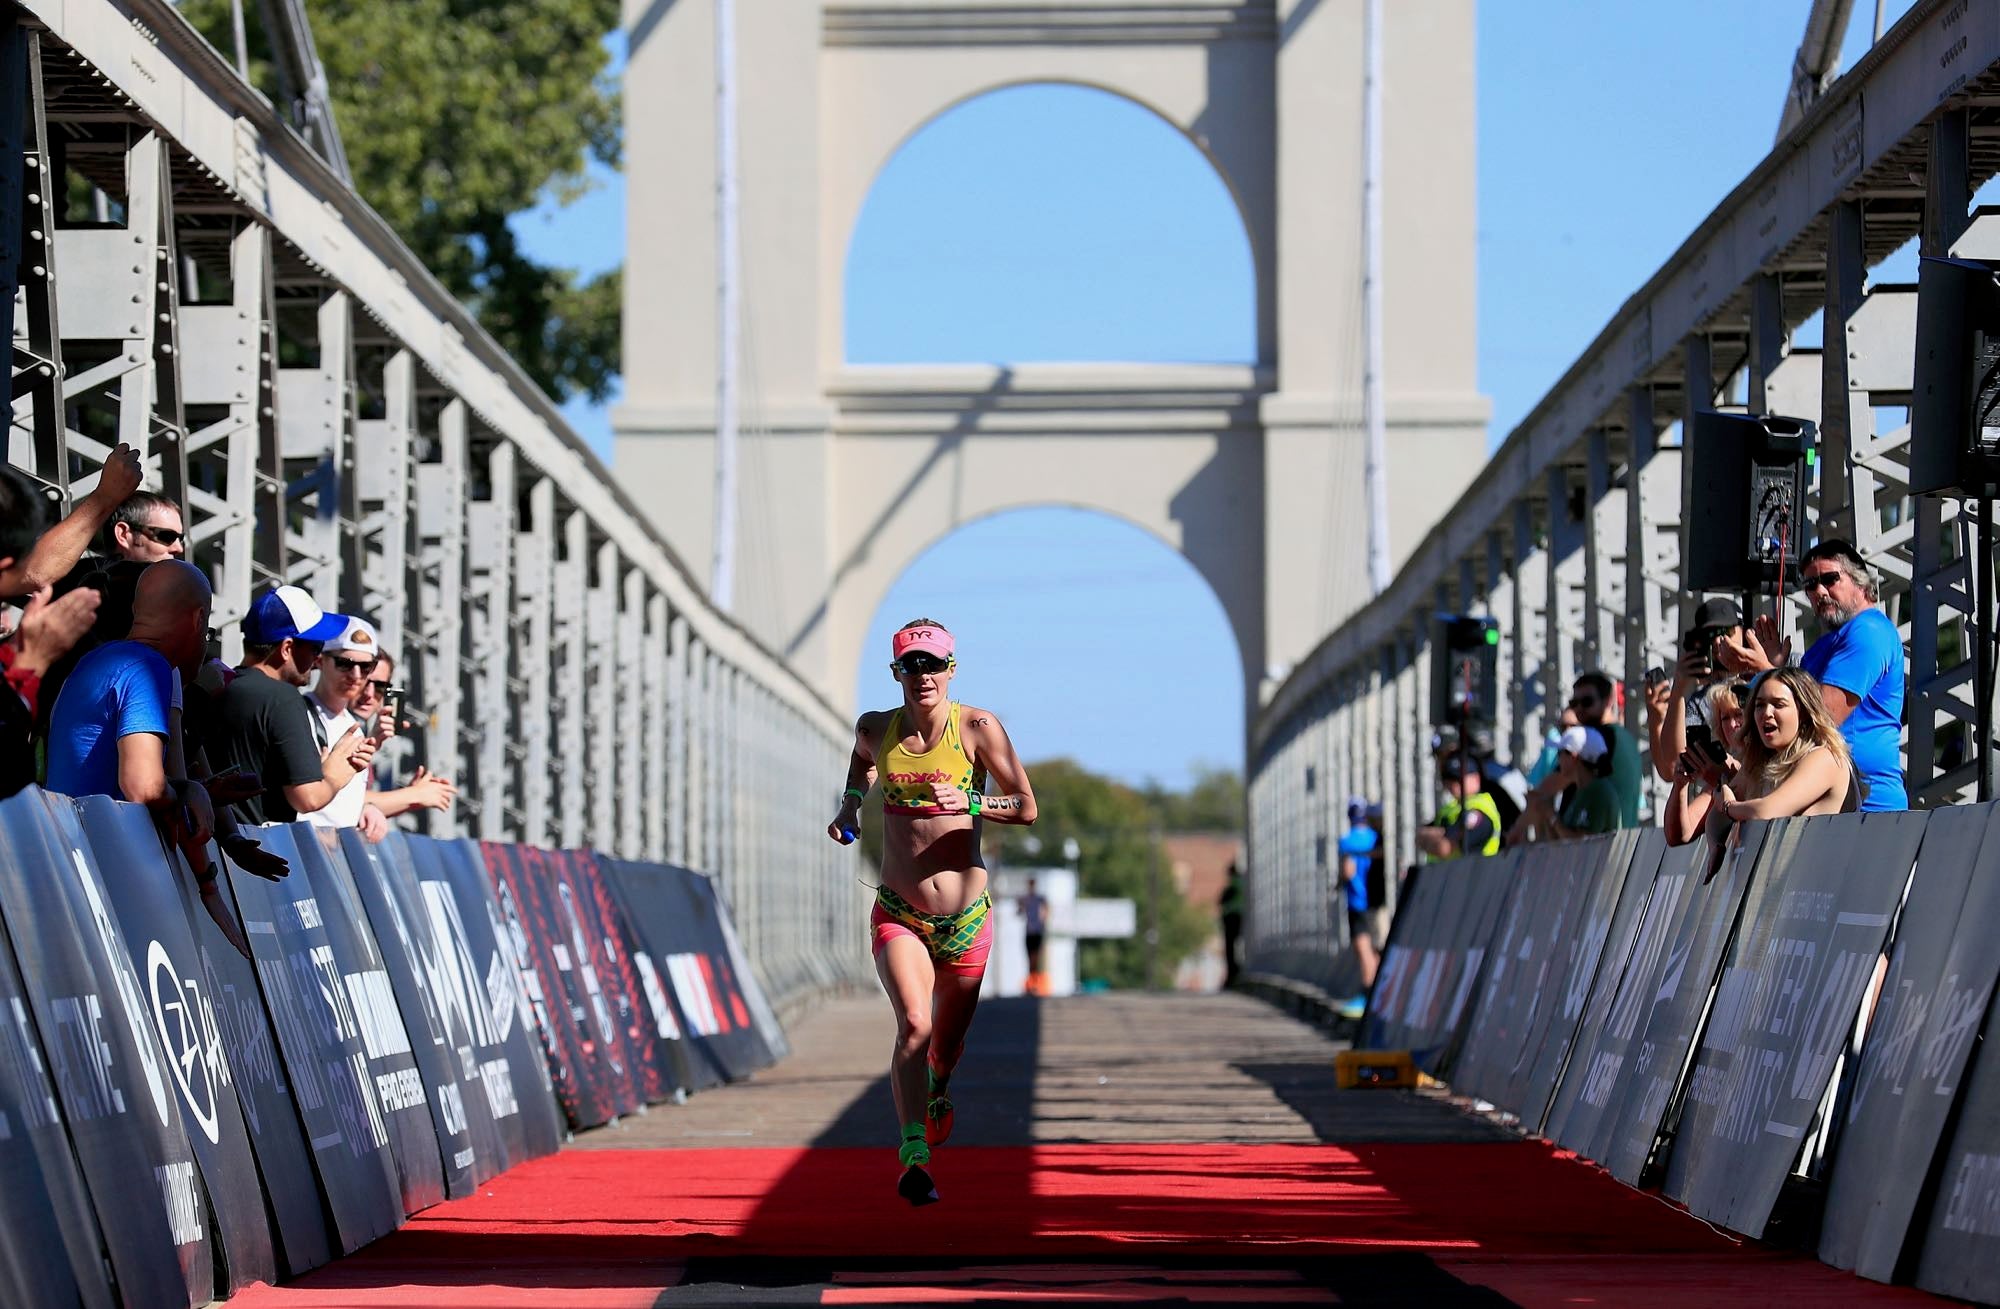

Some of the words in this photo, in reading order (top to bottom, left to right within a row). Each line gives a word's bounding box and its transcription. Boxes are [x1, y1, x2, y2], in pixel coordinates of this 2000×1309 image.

[908, 630, 933, 641] TYR
[969, 717, 989, 728] TYR
[289, 945, 357, 1049] FOSTE
